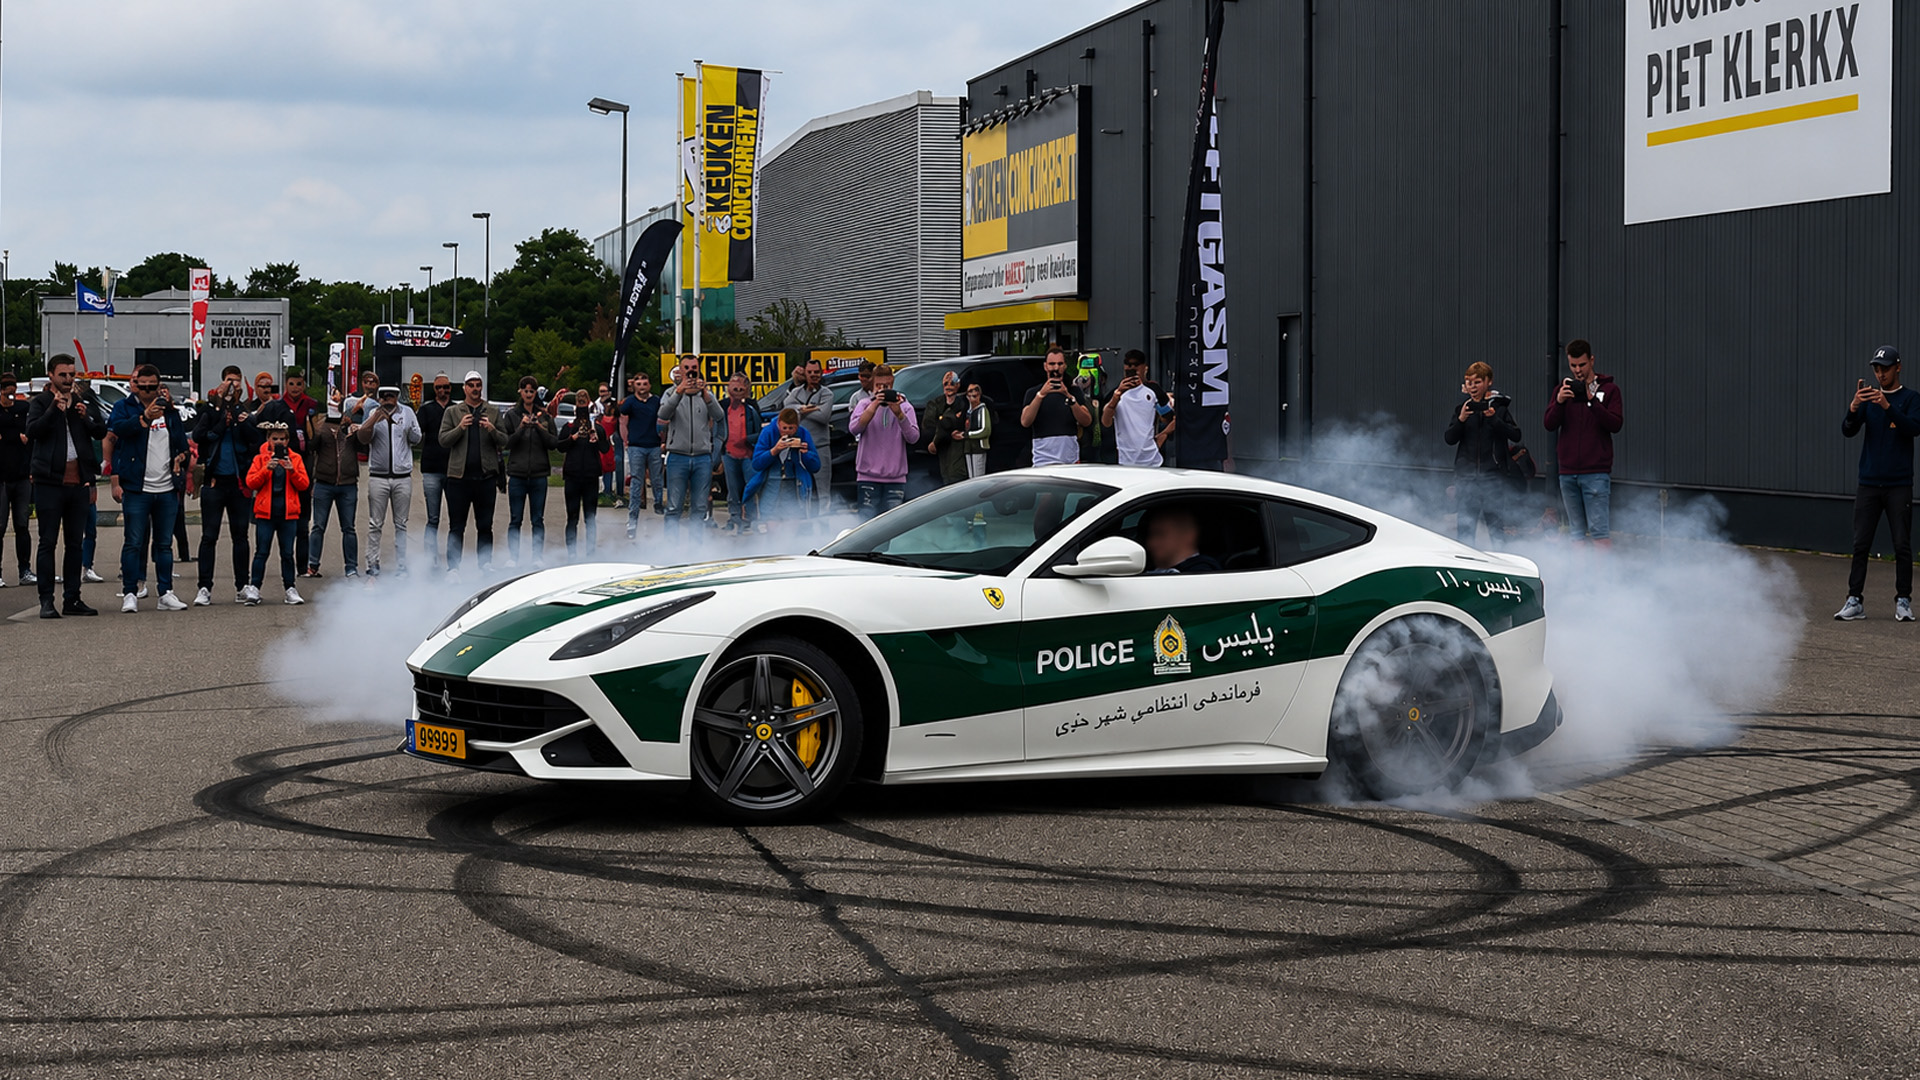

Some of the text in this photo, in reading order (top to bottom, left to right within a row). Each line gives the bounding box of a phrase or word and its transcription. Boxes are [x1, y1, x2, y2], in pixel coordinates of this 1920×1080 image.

[1646, 3, 1860, 118] PIET KLERKX
[705, 104, 736, 213] KEUKEN
[1036, 639, 1135, 675] POLICE
[1202, 612, 1275, 663] پلیس
